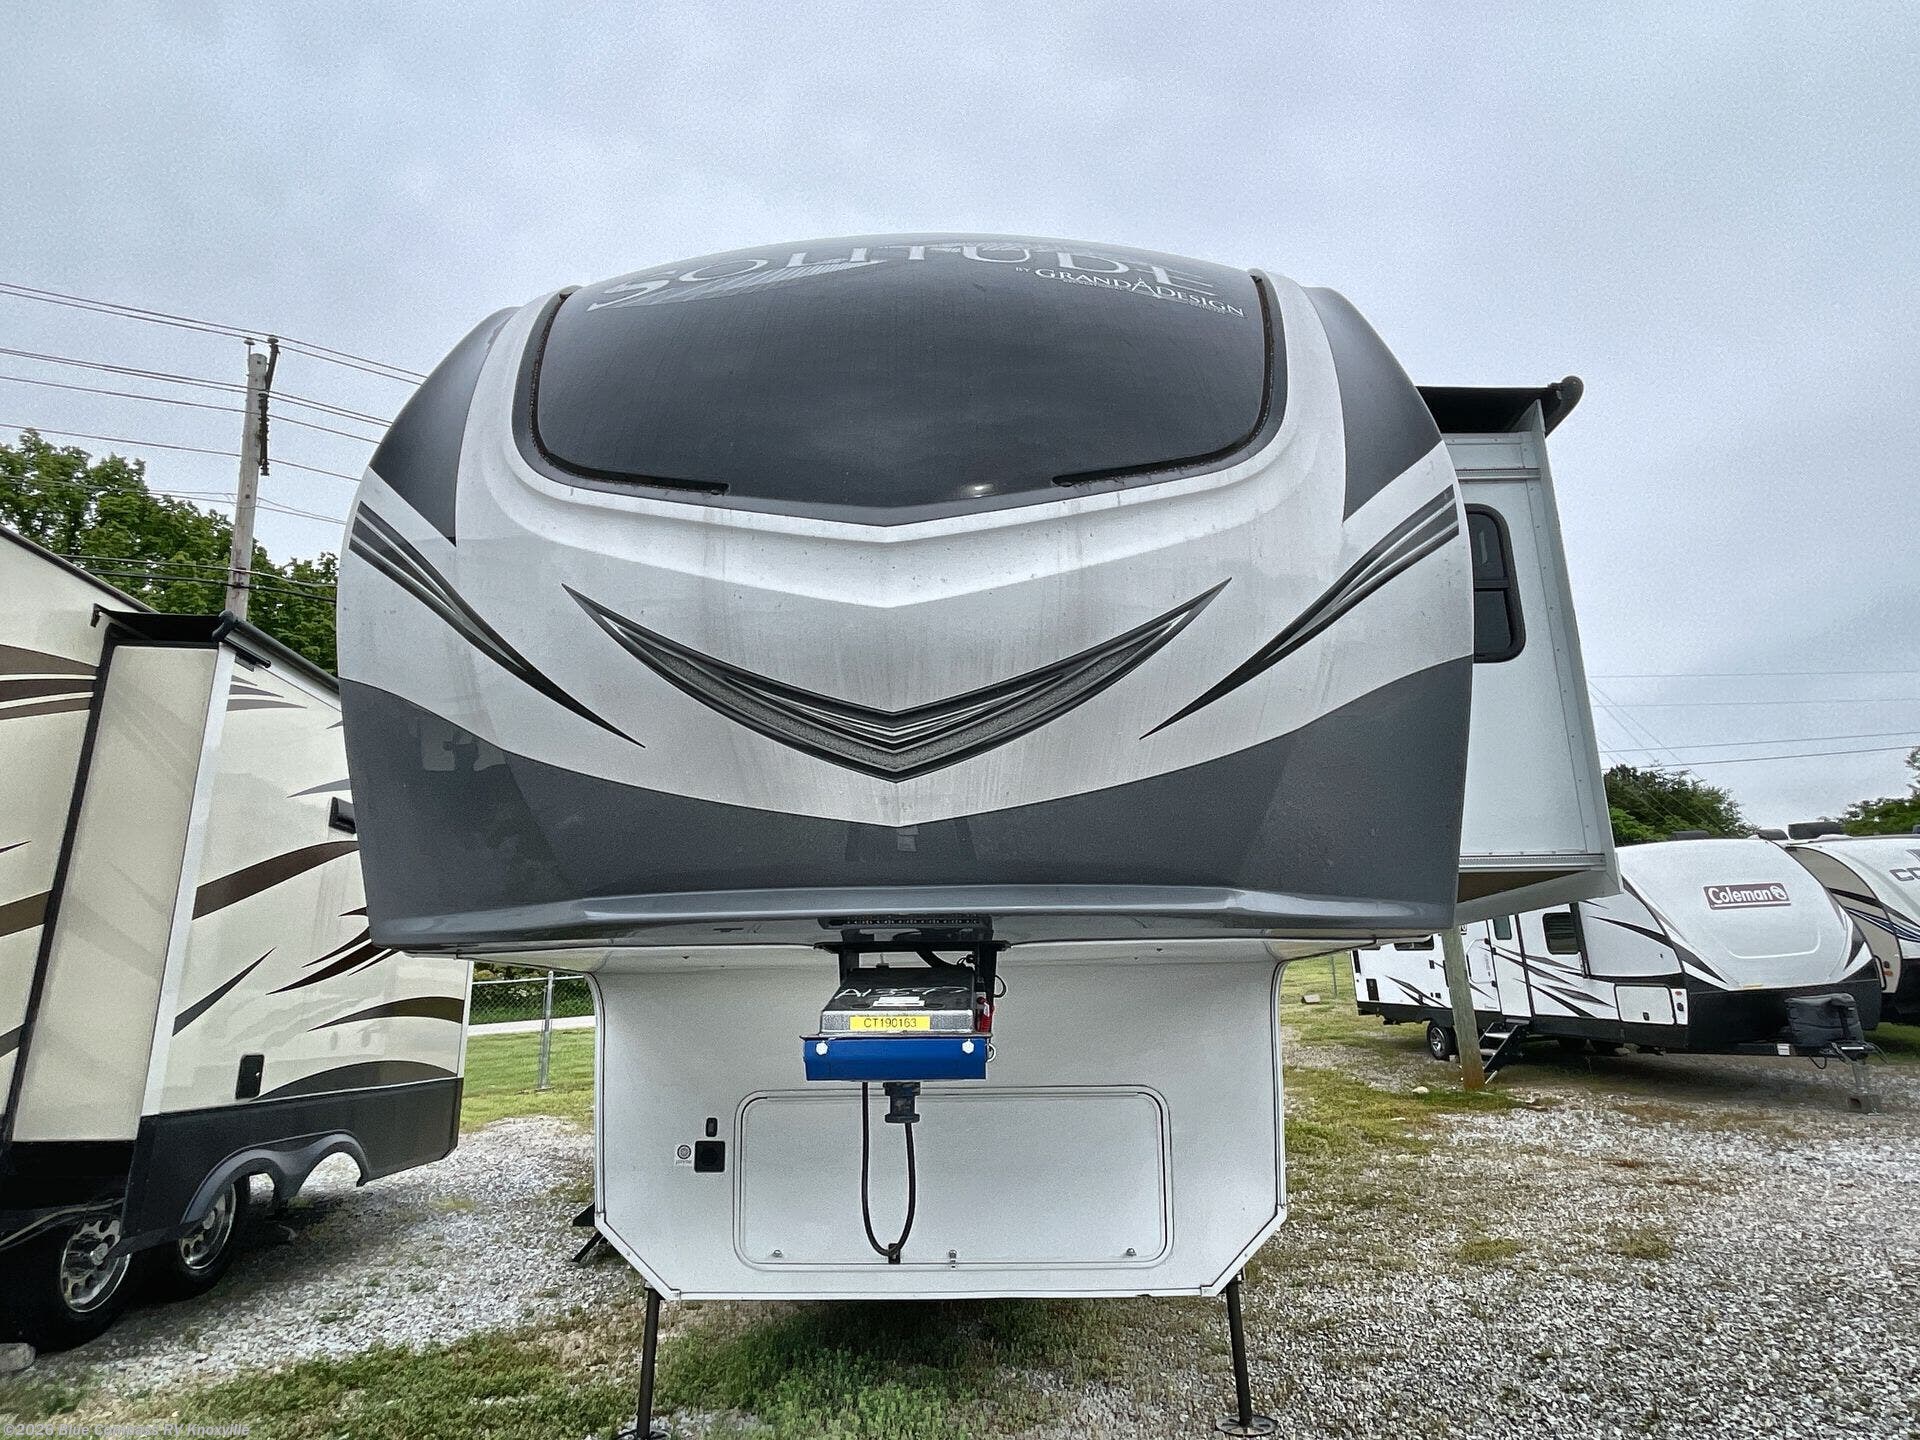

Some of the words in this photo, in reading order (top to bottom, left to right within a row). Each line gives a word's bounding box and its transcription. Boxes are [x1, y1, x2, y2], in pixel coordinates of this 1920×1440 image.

[586, 244, 1217, 312] SOLITUDE
[1035, 268, 1133, 289] GRAND
[1157, 286, 1244, 317] DESIGN
[1708, 886, 1773, 904] Coleman
[863, 1017, 917, 1028] CT190163
